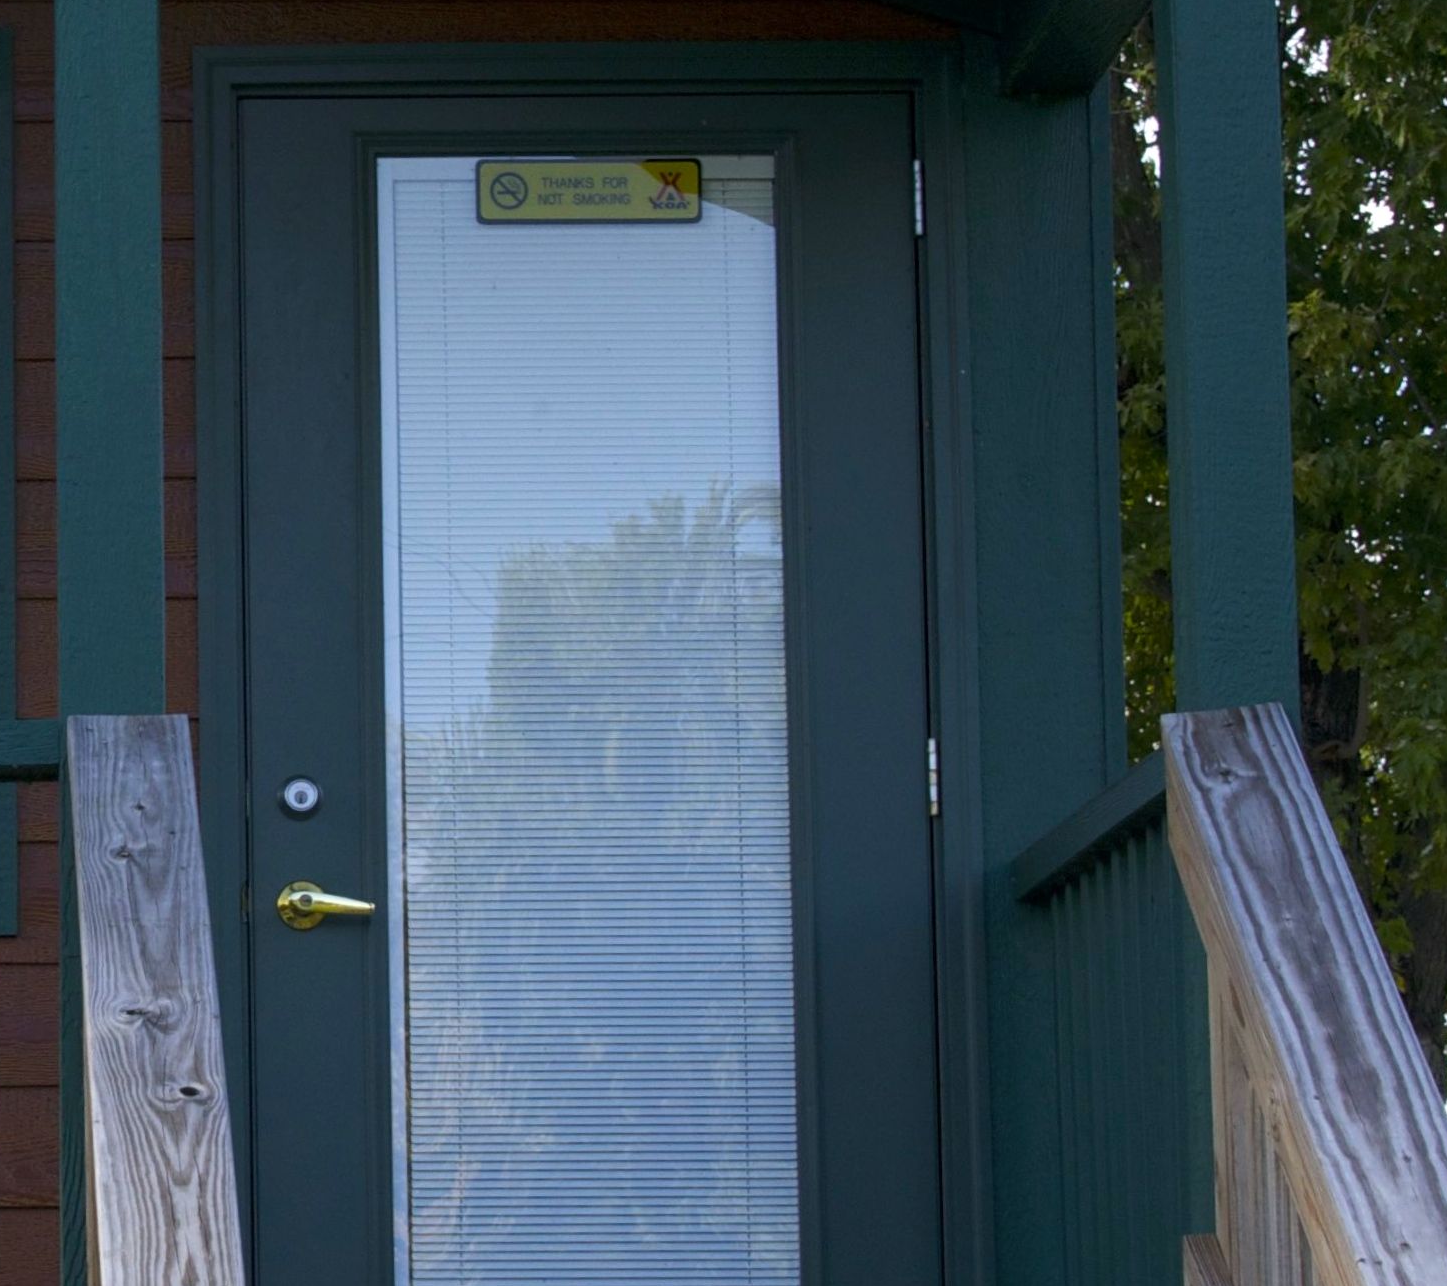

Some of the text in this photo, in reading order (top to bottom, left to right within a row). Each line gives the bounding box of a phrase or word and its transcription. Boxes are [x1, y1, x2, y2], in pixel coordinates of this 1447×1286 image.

[541, 176, 628, 189] THANKS FOR
[537, 192, 631, 205] NOT SMOKING
[651, 200, 687, 210] KOA
